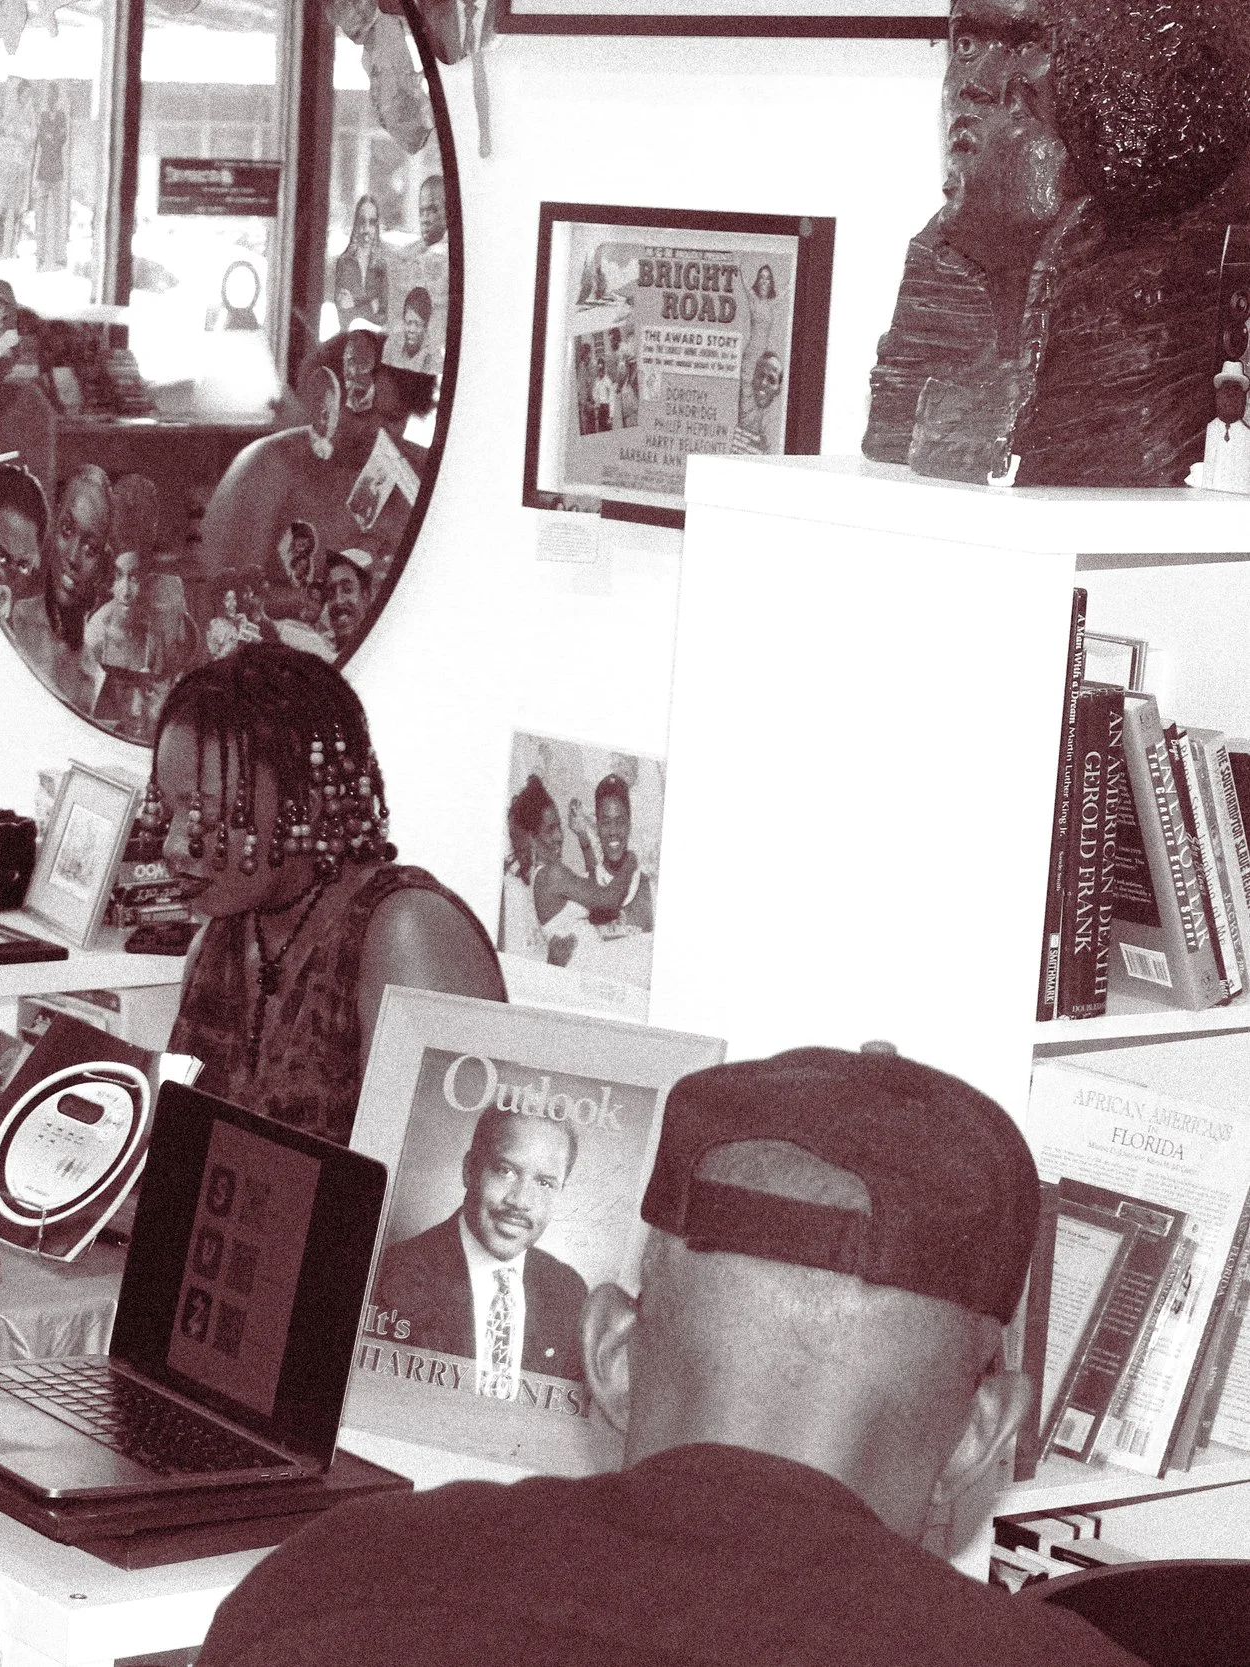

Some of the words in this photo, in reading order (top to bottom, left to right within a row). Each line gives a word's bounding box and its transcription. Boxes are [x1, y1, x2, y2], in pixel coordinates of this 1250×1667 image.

[638, 260, 738, 293] BRIGHT
[662, 291, 737, 323] ROAD
[645, 330, 661, 342] THE
[665, 332, 703, 346] AWARD
[707, 335, 738, 348] STORY
[666, 387, 708, 402] DOROTHY
[666, 403, 718, 421] DANDRIDGE
[646, 435, 674, 448] HARRY
[687, 421, 728, 437] HEPBURN
[1075, 625, 1085, 649] Man
[1073, 651, 1083, 679] With
[1069, 690, 1080, 725] Dream
[1066, 727, 1076, 763] Martin
[1109, 711, 1123, 747] AN
[1216, 744, 1227, 767] THE
[1063, 764, 1073, 798] Luther
[1059, 801, 1070, 824] King
[1080, 751, 1101, 859] GEROLD
[1220, 762, 1244, 840] SOUTHAMPTON
[1059, 825, 1068, 837] Jr.
[1101, 755, 1124, 894] AMERICAN
[1148, 752, 1161, 778] THE
[1155, 786, 1175, 847] CHARLES
[1170, 854, 1186, 897] EVERS
[1180, 905, 1197, 948] STORY
[1155, 739, 1179, 816] HAVE
[1174, 823, 1193, 868] NO
[1186, 878, 1209, 949] FEAR
[1074, 866, 1095, 956] FRANK
[1094, 904, 1112, 995] DEATH
[1046, 949, 1057, 1005] SMITHMARK
[443, 1054, 625, 1131] Outlook
[1072, 1088, 1146, 1120] AFRICAN
[1149, 1107, 1234, 1142] AMERICANS
[1111, 1126, 1184, 1161] FLORIDA
[1217, 1245, 1240, 1298] FLORIDA
[363, 1303, 411, 1340] It's
[358, 1344, 469, 1391] HARRY
